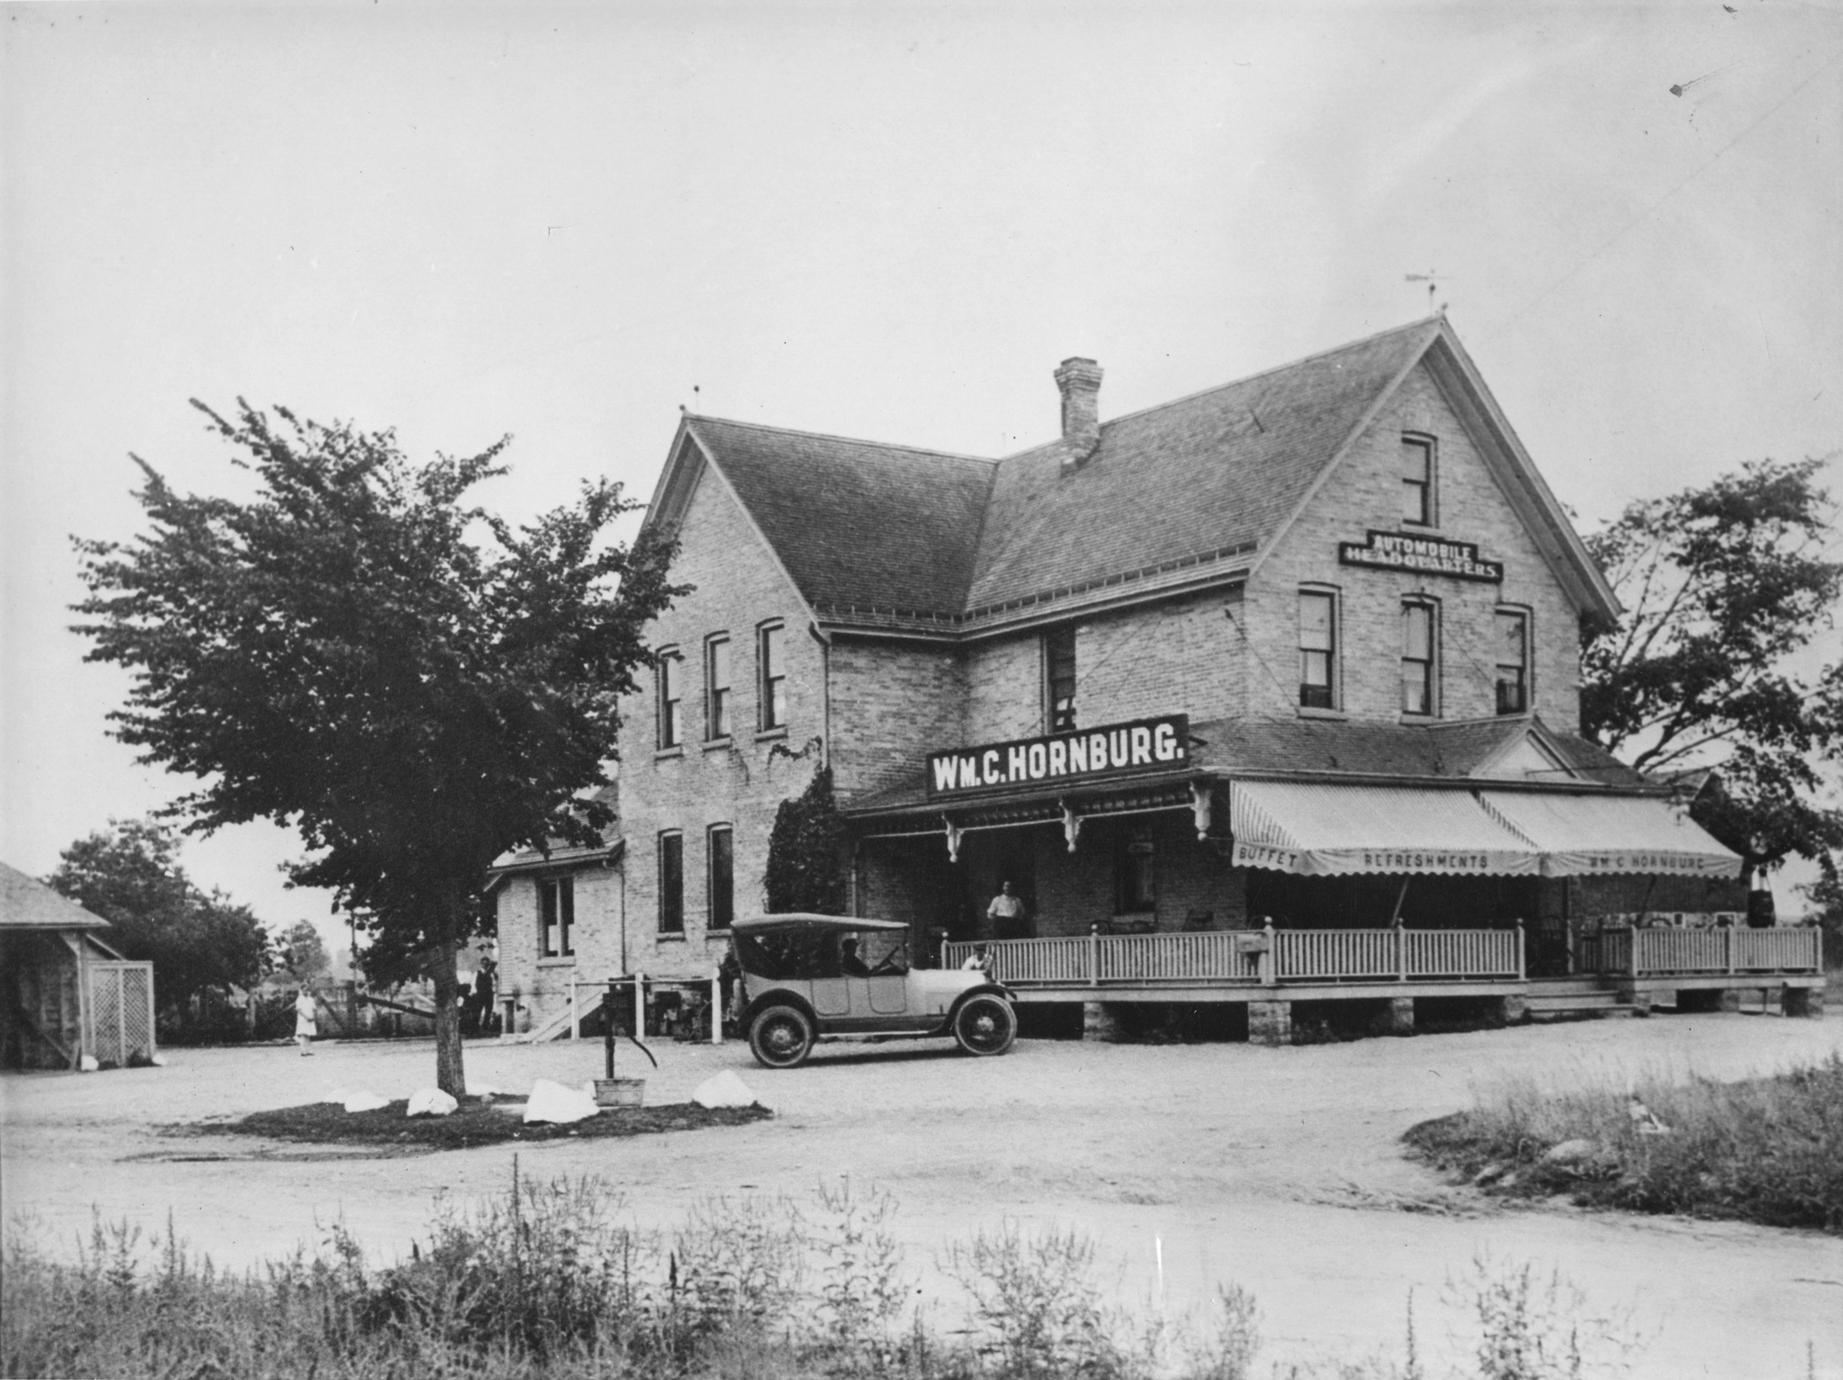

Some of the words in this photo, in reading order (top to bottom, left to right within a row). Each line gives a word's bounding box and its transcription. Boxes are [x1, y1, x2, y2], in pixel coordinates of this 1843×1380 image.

[1374, 535, 1471, 561] AUTOMOBILE
[1239, 847, 1297, 867] BUFFET
[1364, 853, 1487, 868] REFRESHMENTS
